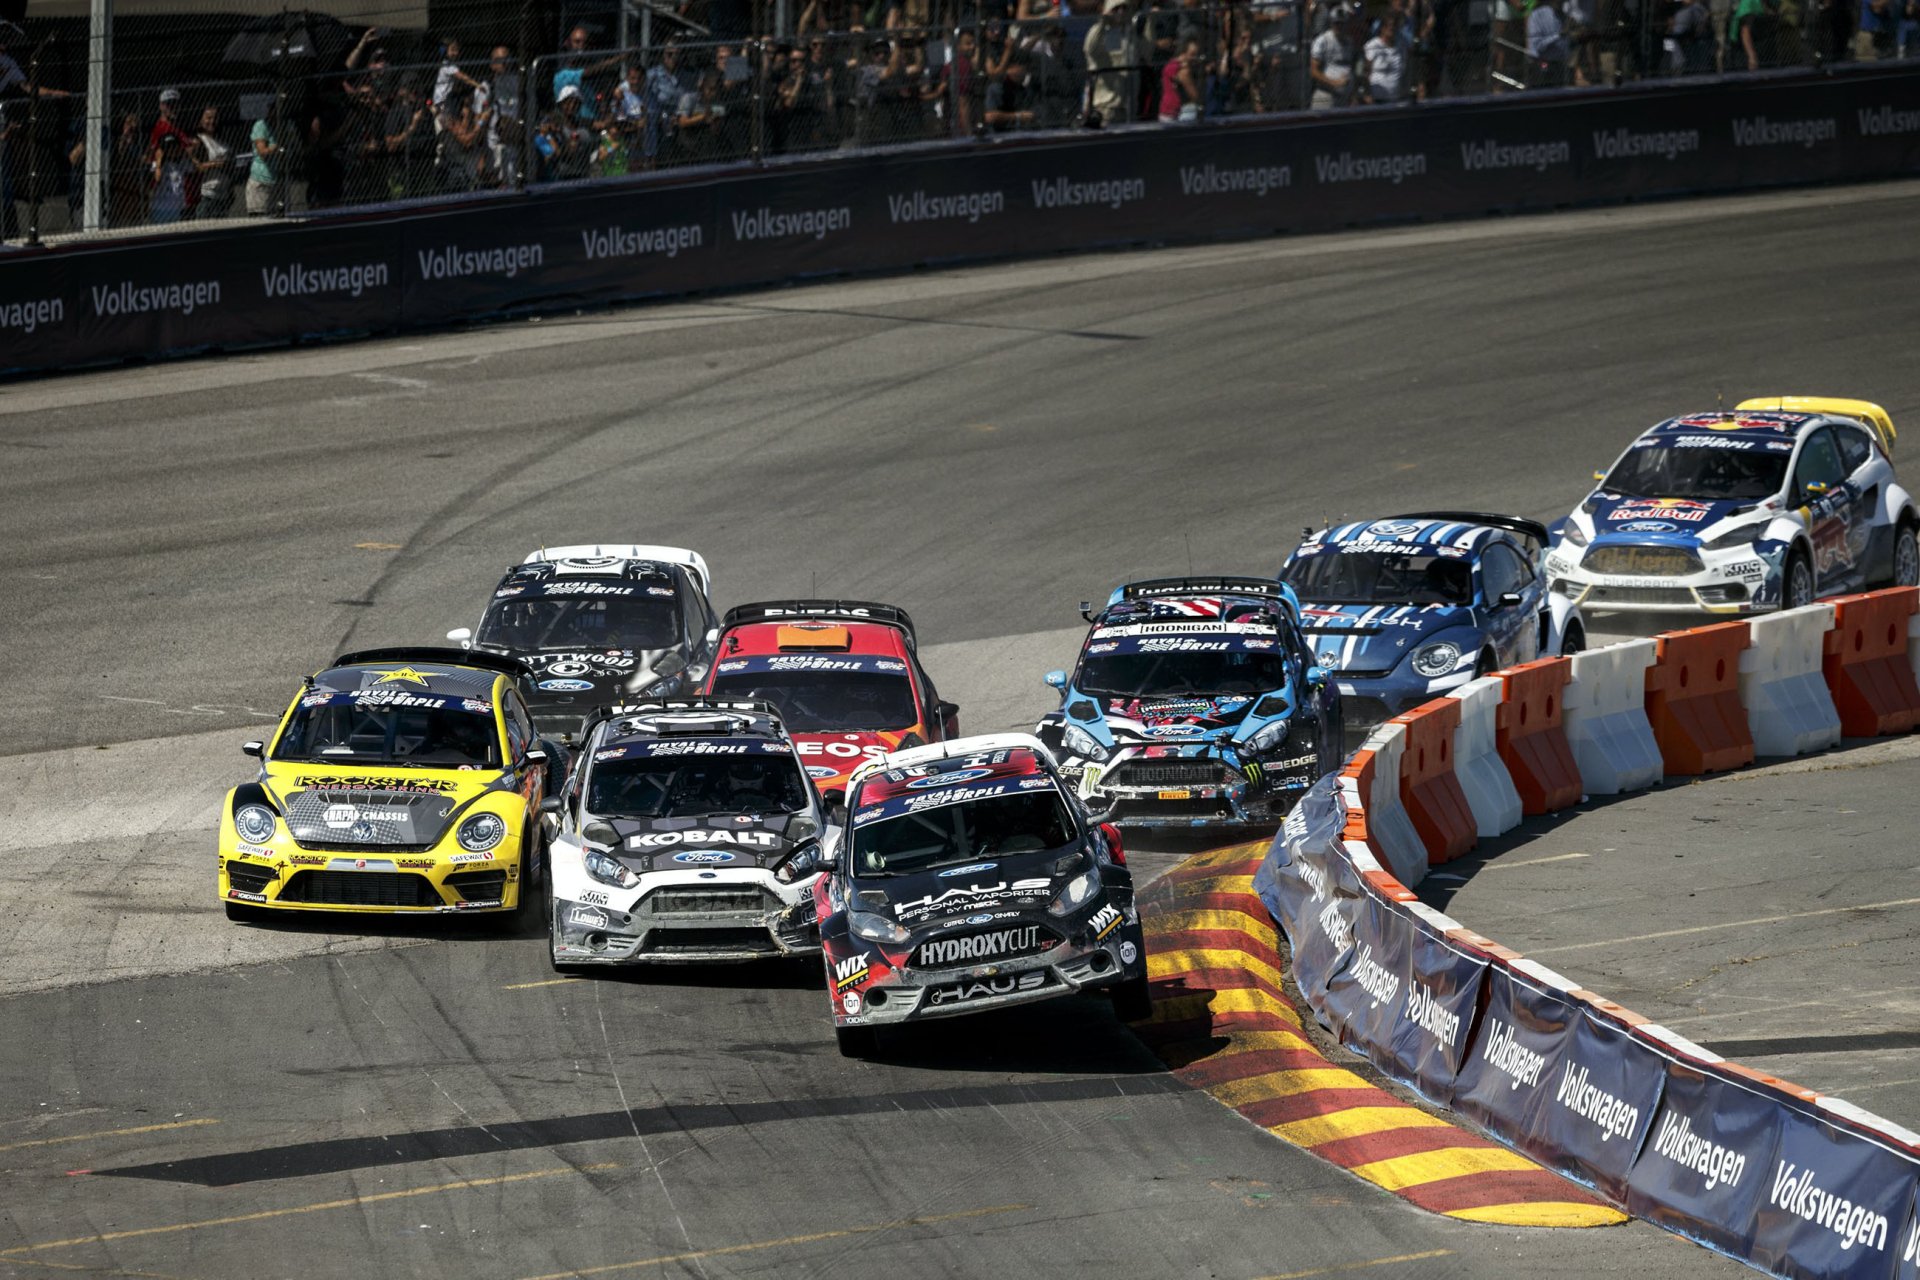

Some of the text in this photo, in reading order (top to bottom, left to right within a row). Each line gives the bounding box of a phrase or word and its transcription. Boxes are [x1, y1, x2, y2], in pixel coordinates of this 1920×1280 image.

[1593, 128, 1700, 161] Volkswagen
[1733, 116, 1836, 148] Volkswagen
[1316, 152, 1427, 185] Volkswagen
[1461, 140, 1570, 172] Volkswagen
[1032, 177, 1145, 210] Volkswagen
[1180, 164, 1291, 197] Volkswagen
[889, 191, 1004, 223] Volkswagen
[732, 207, 851, 241] Volkswagen
[583, 224, 702, 260] Volkswagen
[419, 242, 544, 280] Volkswagen
[263, 262, 388, 299] Volkswagen
[93, 279, 221, 317] Volkswagen
[1608, 509, 1707, 521] Red Bull
[1627, 523, 1666, 532] Ford
[571, 584, 634, 596] PURPLE
[1603, 577, 1672, 588] bluebeam
[1169, 643, 1230, 651] PURPLE
[800, 661, 862, 671] PURPLE
[547, 680, 583, 691] Ford
[381, 696, 447, 709] PURPLE
[1153, 726, 1193, 736] Ford
[683, 743, 749, 756] PURPLE
[1283, 755, 1318, 769] EDGE
[926, 771, 972, 786] Ford
[1057, 766, 1083, 776] EDGE
[1271, 775, 1309, 786] GoPro
[940, 785, 1004, 804] PURPLE
[328, 811, 408, 823] NAPA CHASSIS
[686, 851, 723, 862] Ford
[950, 864, 989, 875] Ford
[894, 878, 1052, 915] HAUS
[898, 888, 1052, 923] PERSONAL VAPORIZER
[947, 905, 961, 915] BY
[1087, 902, 1121, 935] WIX
[921, 925, 1040, 966] HYDROXYCUT
[835, 951, 871, 981] WIX
[837, 974, 869, 995] FILTERS
[940, 972, 1046, 1001] HAUS
[1483, 1018, 1545, 1092] Volkswagen
[1556, 1060, 1639, 1142] Volkswagen
[1654, 1111, 1746, 1192] Volkswagen
[1771, 1159, 1888, 1251] Volkswagen
